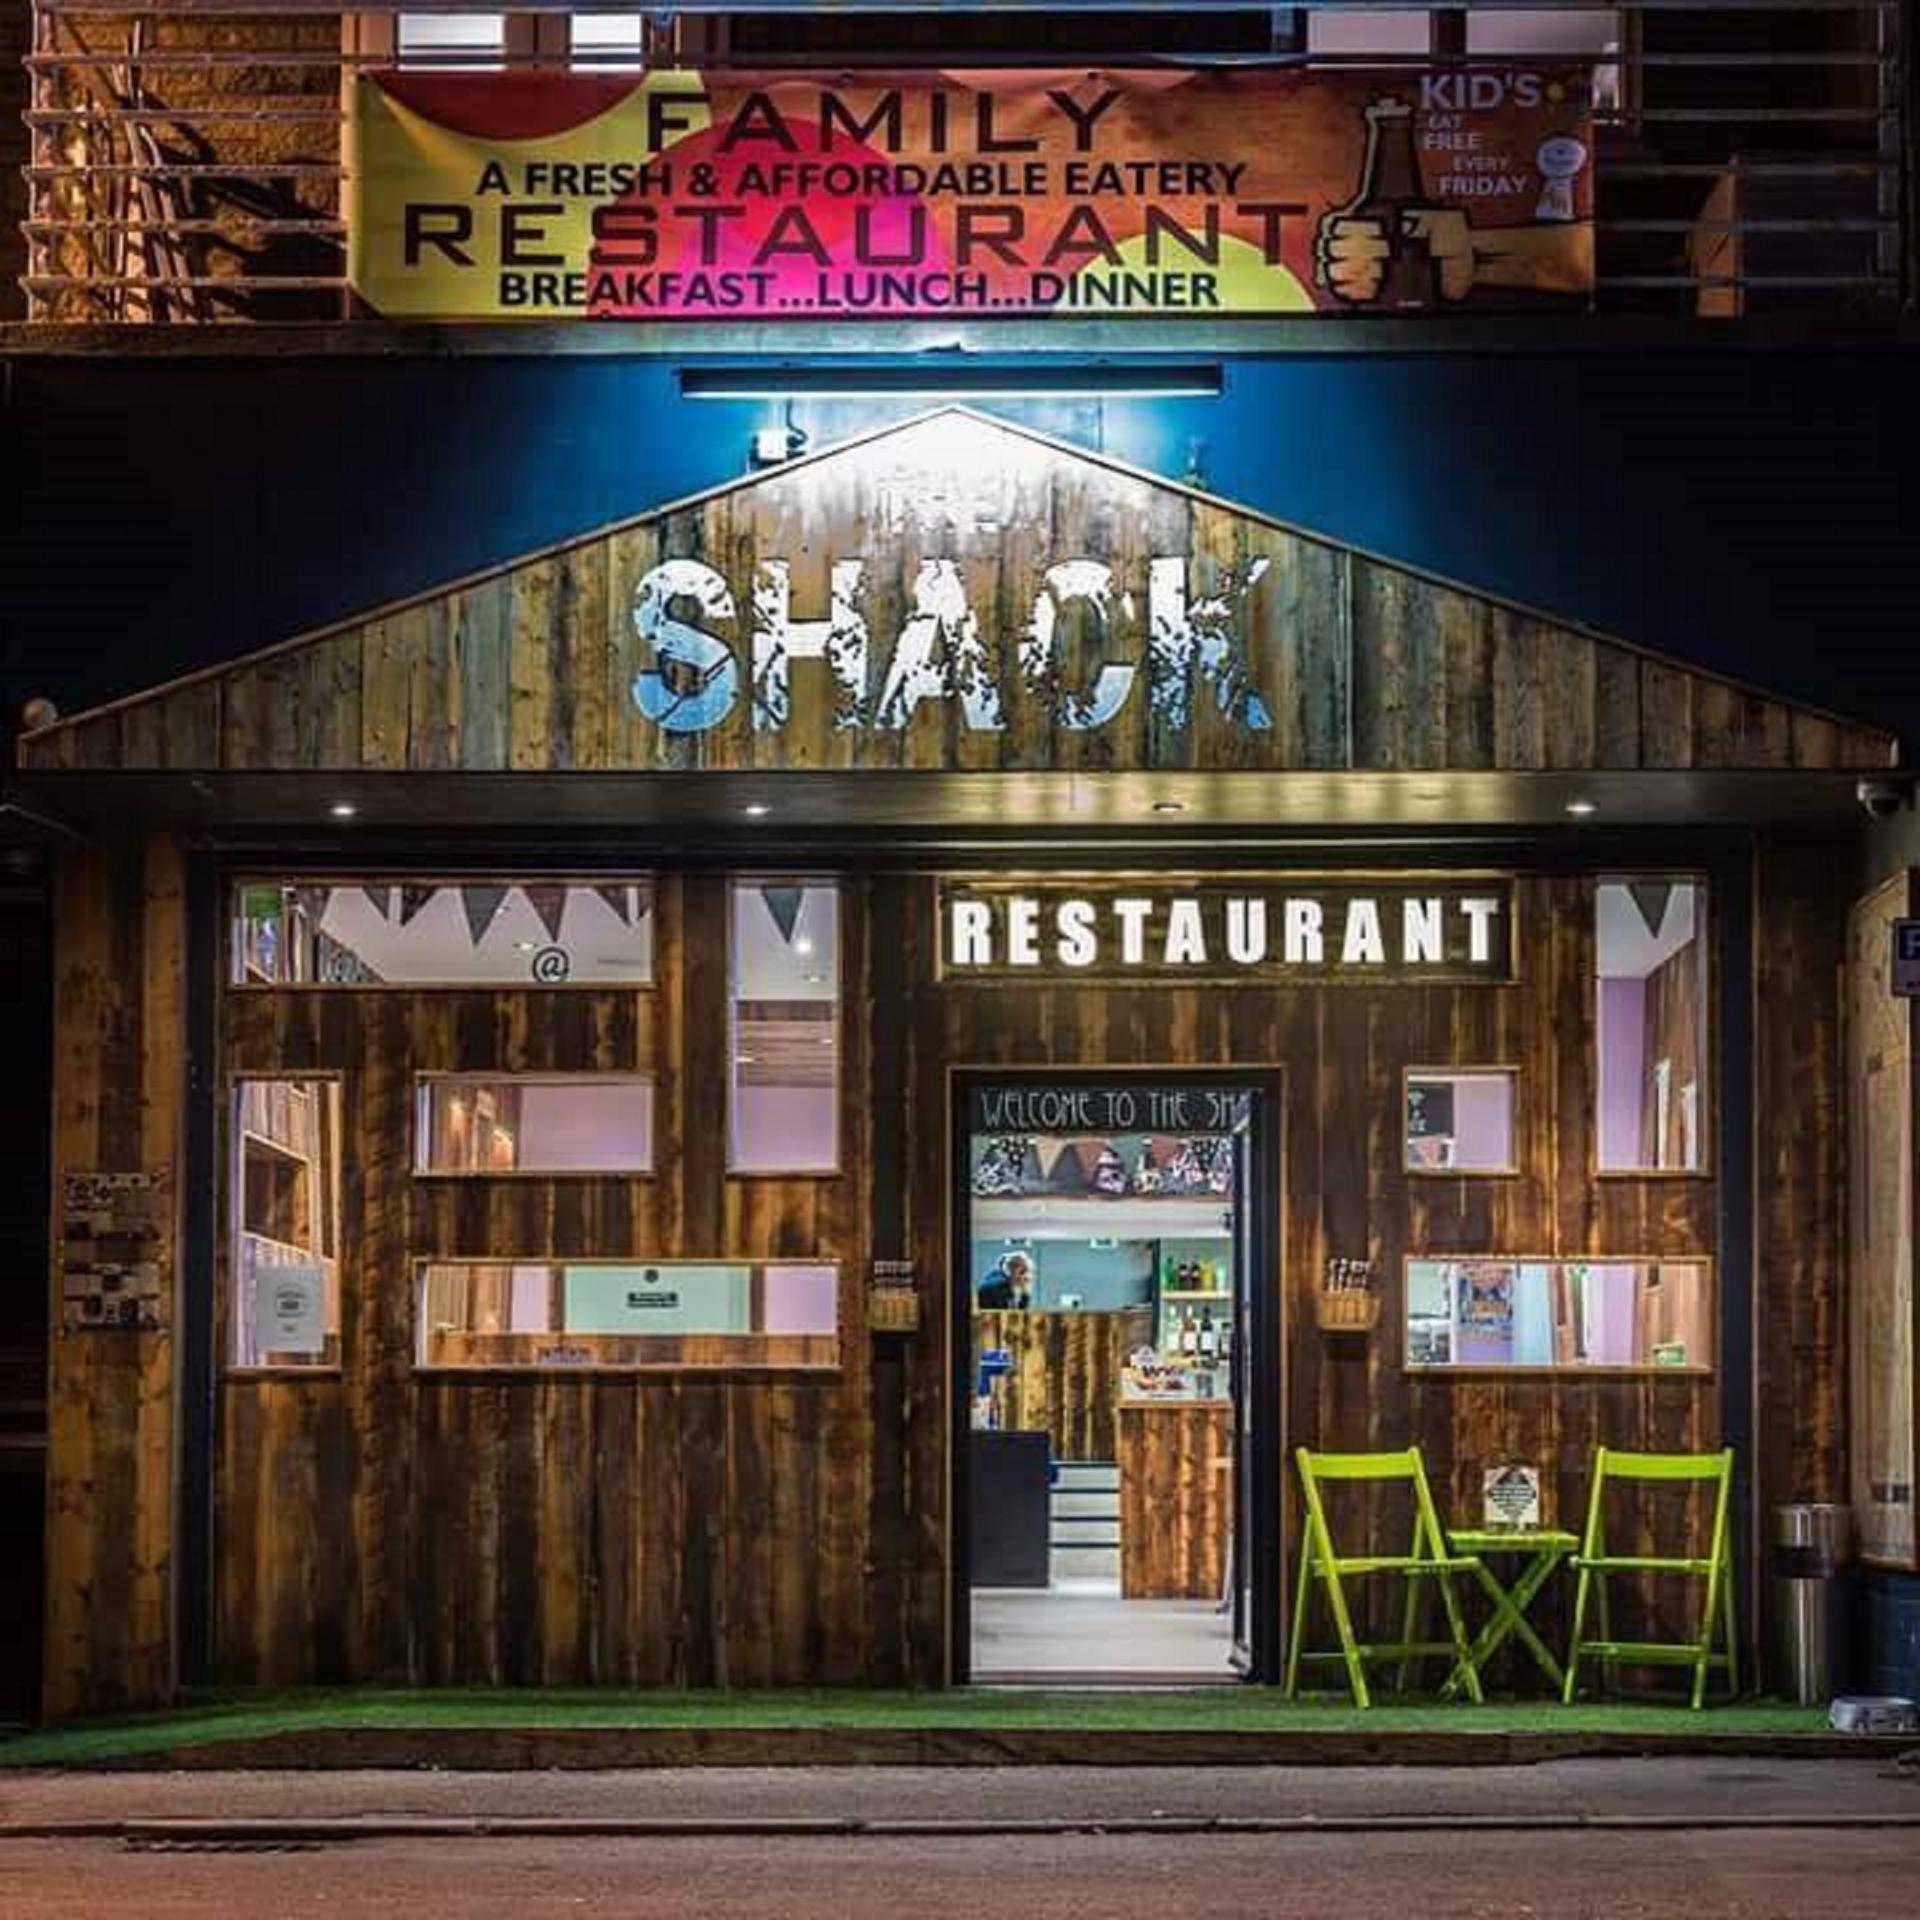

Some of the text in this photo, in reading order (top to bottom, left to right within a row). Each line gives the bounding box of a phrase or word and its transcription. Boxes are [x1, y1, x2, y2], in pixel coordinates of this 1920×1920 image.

[1420, 74, 1541, 109] KID'S
[647, 89, 1125, 153] FAMILY
[1424, 132, 1482, 150] FREE
[476, 162, 1247, 197] A FRESH & AFFORDABLE EATERY
[1453, 156, 1510, 171] EVERY
[1440, 176, 1528, 196] FRIDAY
[404, 204, 1308, 267] RESTAURANT
[634, 557, 1272, 733] SHACK
[950, 898, 1500, 966] RESTAURANT
[981, 1091, 1093, 1128] WELCOME
[1103, 1091, 1135, 1128] TO
[1150, 1091, 1189, 1128] THE
